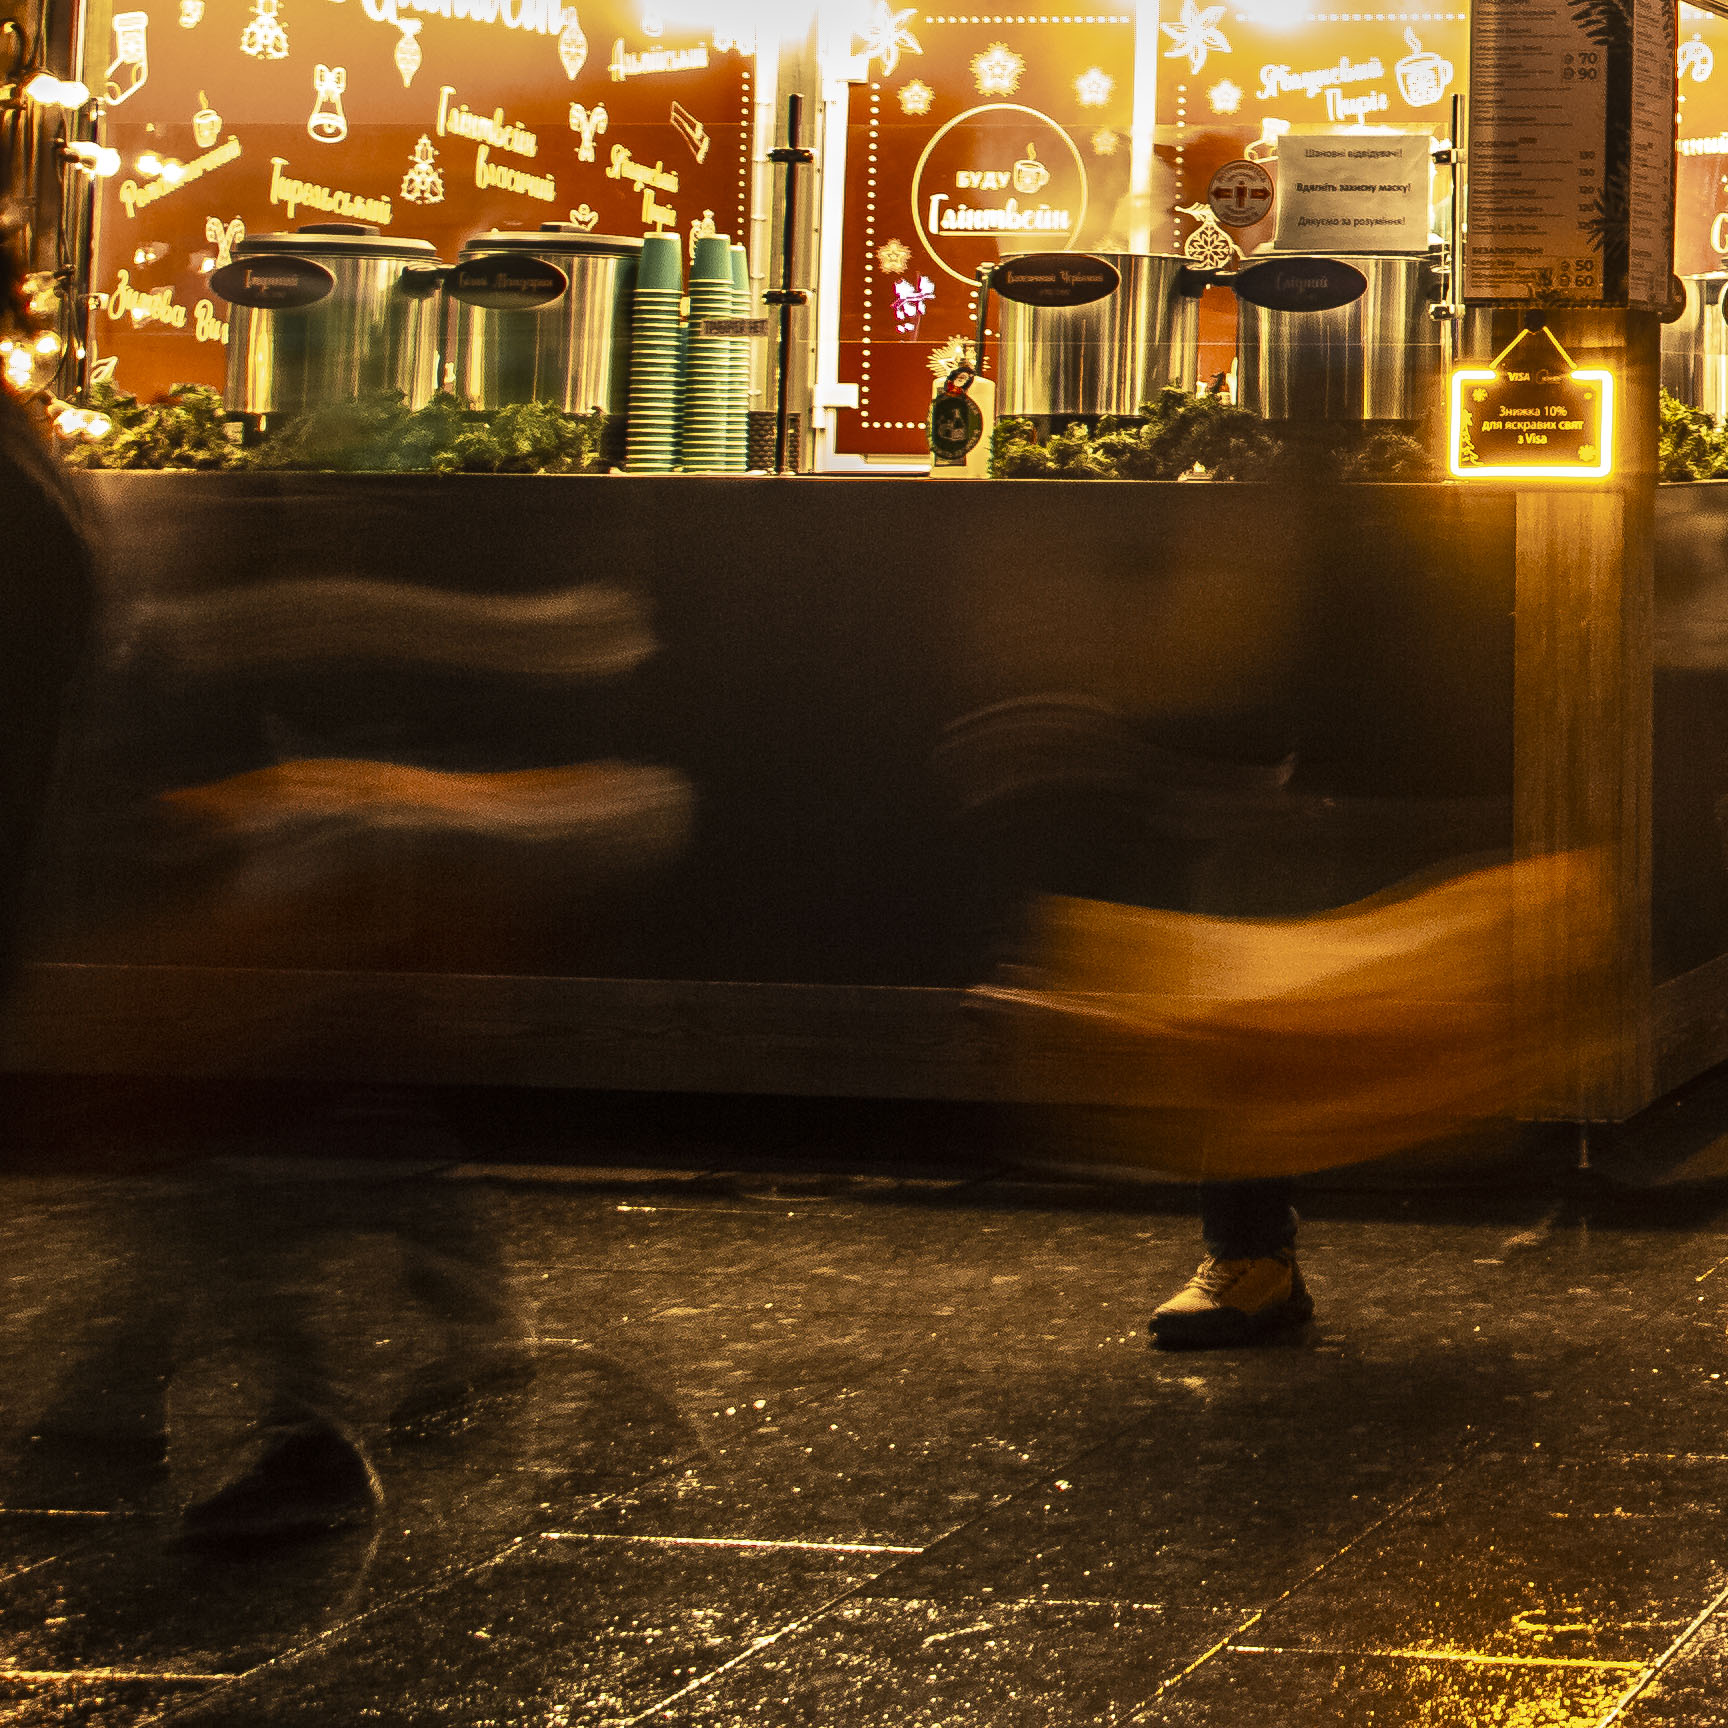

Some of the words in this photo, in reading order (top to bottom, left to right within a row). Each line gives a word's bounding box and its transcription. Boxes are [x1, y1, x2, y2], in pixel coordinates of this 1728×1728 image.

[1578, 52, 1598, 64] 70
[1577, 67, 1597, 80] 90
[956, 170, 1012, 190] БУДУ
[1378, 183, 1411, 194] маску!
[929, 193, 1071, 234] Глінтвейн
[1297, 217, 1338, 227] Дякуємо
[1575, 260, 1594, 271] 50
[1575, 275, 1594, 287] 60
[1507, 371, 1530, 382] VISA
[1499, 405, 1540, 417] Знижка
[1544, 405, 1567, 417] 10%
[1481, 421, 1503, 431] для
[1504, 421, 1557, 432] яскравих
[1558, 421, 1584, 430] свят
[1517, 435, 1524, 444] з
[1525, 433, 1548, 444] Visa
